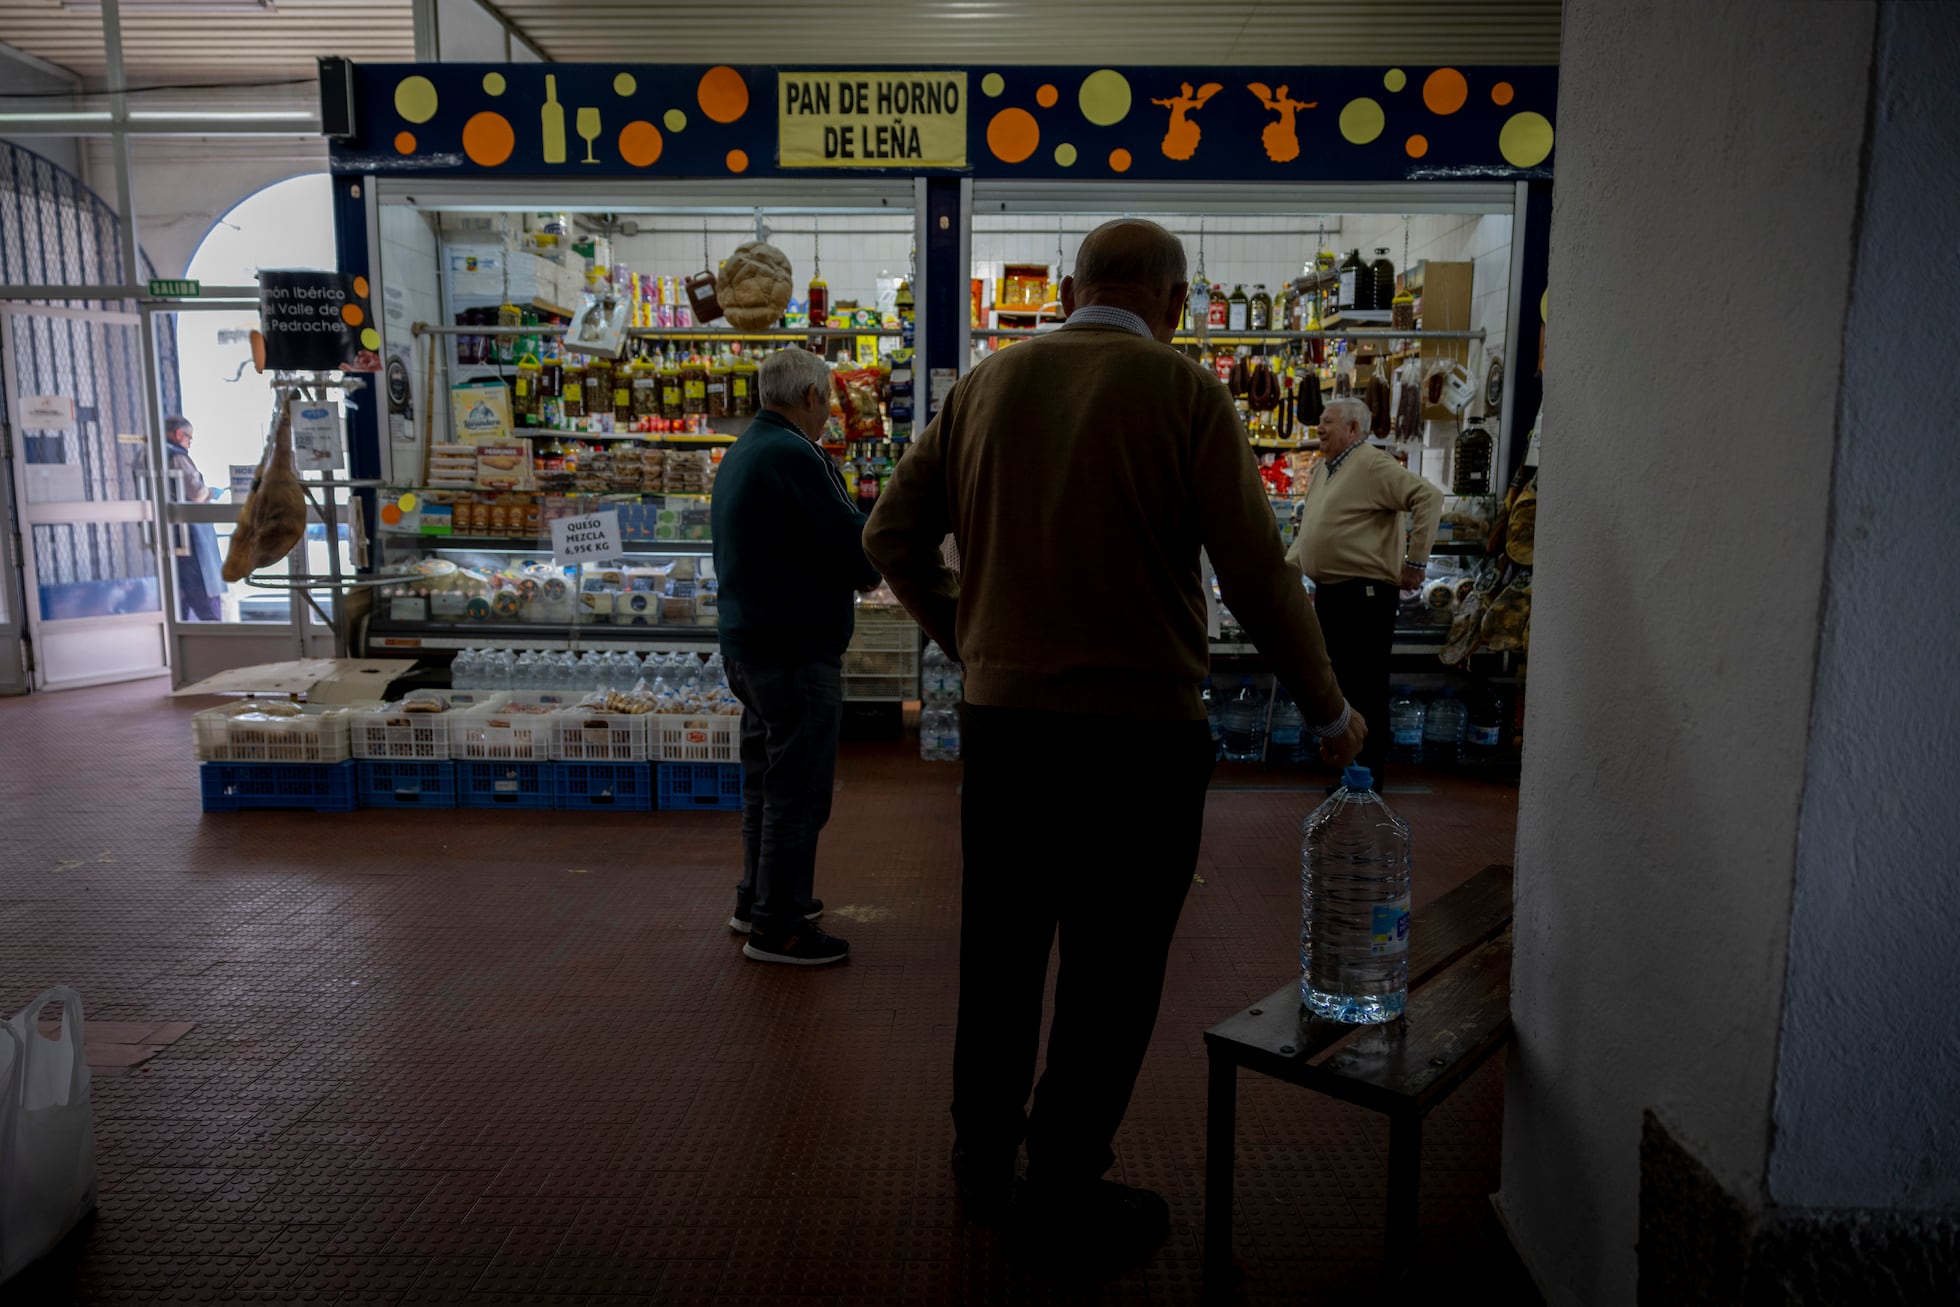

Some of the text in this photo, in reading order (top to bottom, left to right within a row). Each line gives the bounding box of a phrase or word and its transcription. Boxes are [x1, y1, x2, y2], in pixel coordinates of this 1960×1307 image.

[786, 81, 959, 114] PAN DE HORNO
[824, 118, 922, 158] DE LEÑA
[152, 281, 198, 295] SALIDA
[293, 285, 346, 300] Ibérico
[278, 303, 314, 316] Valle
[318, 303, 340, 316] de
[271, 319, 348, 333] Pedroches
[567, 520, 601, 532] QUESO
[566, 531, 606, 543] MEZCLA
[565, 541, 609, 555] 6,95€ KG
